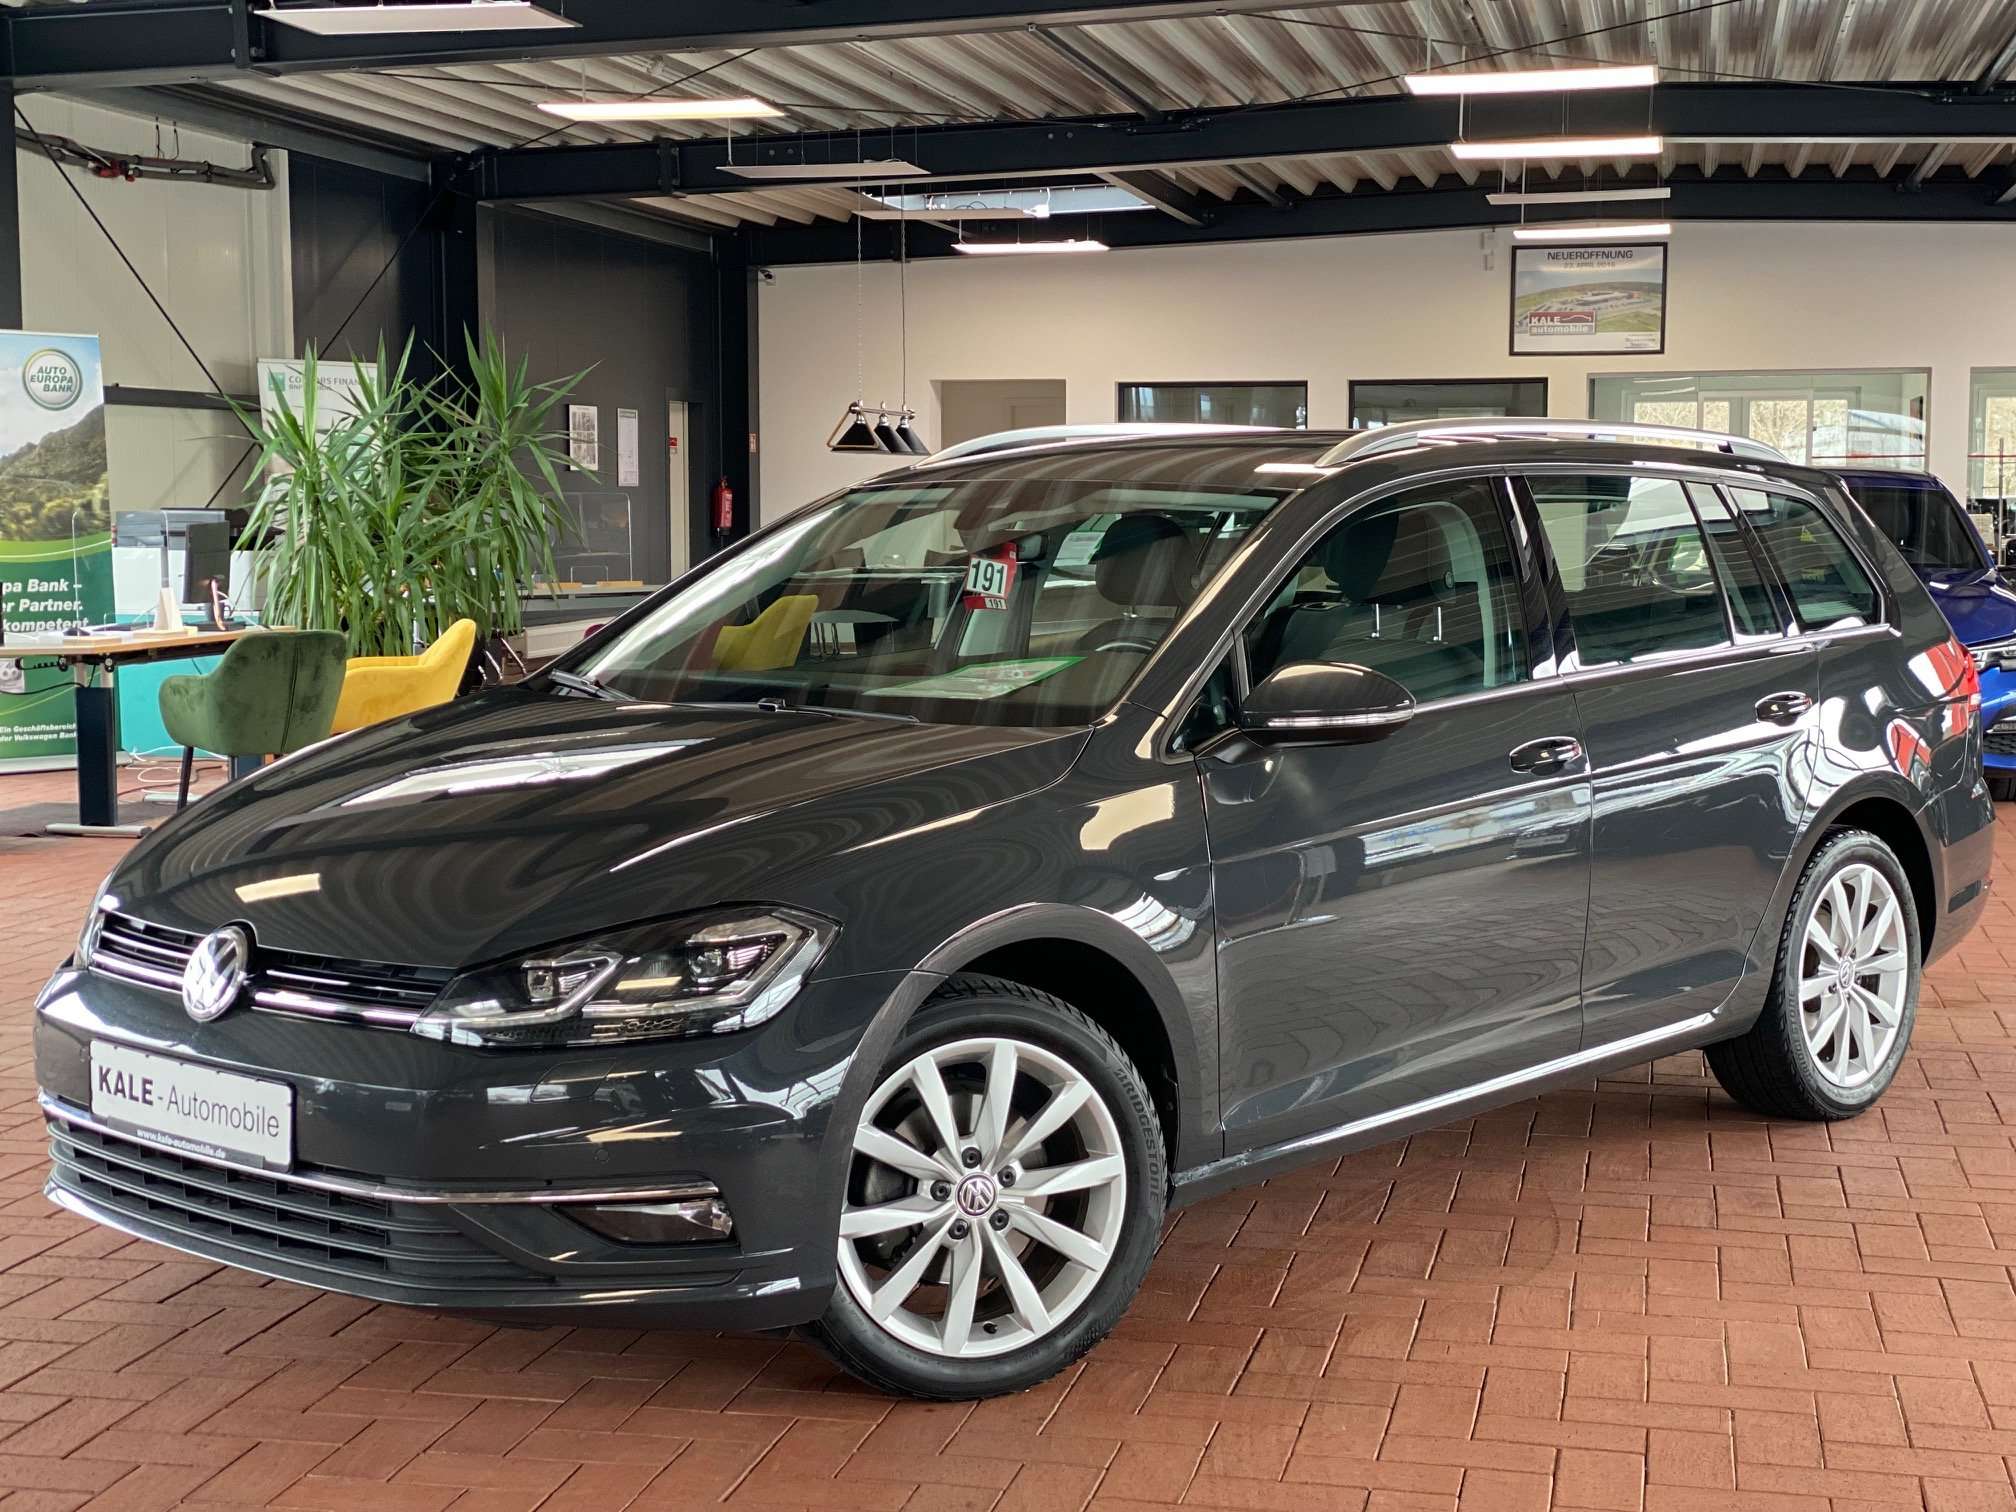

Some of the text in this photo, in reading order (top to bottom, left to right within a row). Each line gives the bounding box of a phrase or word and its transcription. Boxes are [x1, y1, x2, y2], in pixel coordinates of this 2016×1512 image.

[1531, 316, 1561, 325] KALE
[37, 366, 67, 375] AUTO
[30, 375, 73, 384] EUROPA
[43, 383, 73, 392] BANK
[971, 560, 1005, 594] 191
[2, 581, 22, 596] pa
[27, 578, 70, 592] Bank
[18, 598, 83, 612] Partner.
[3, 617, 89, 632] kompetent
[1113, 1067, 1161, 1202] BRIDGESTONE
